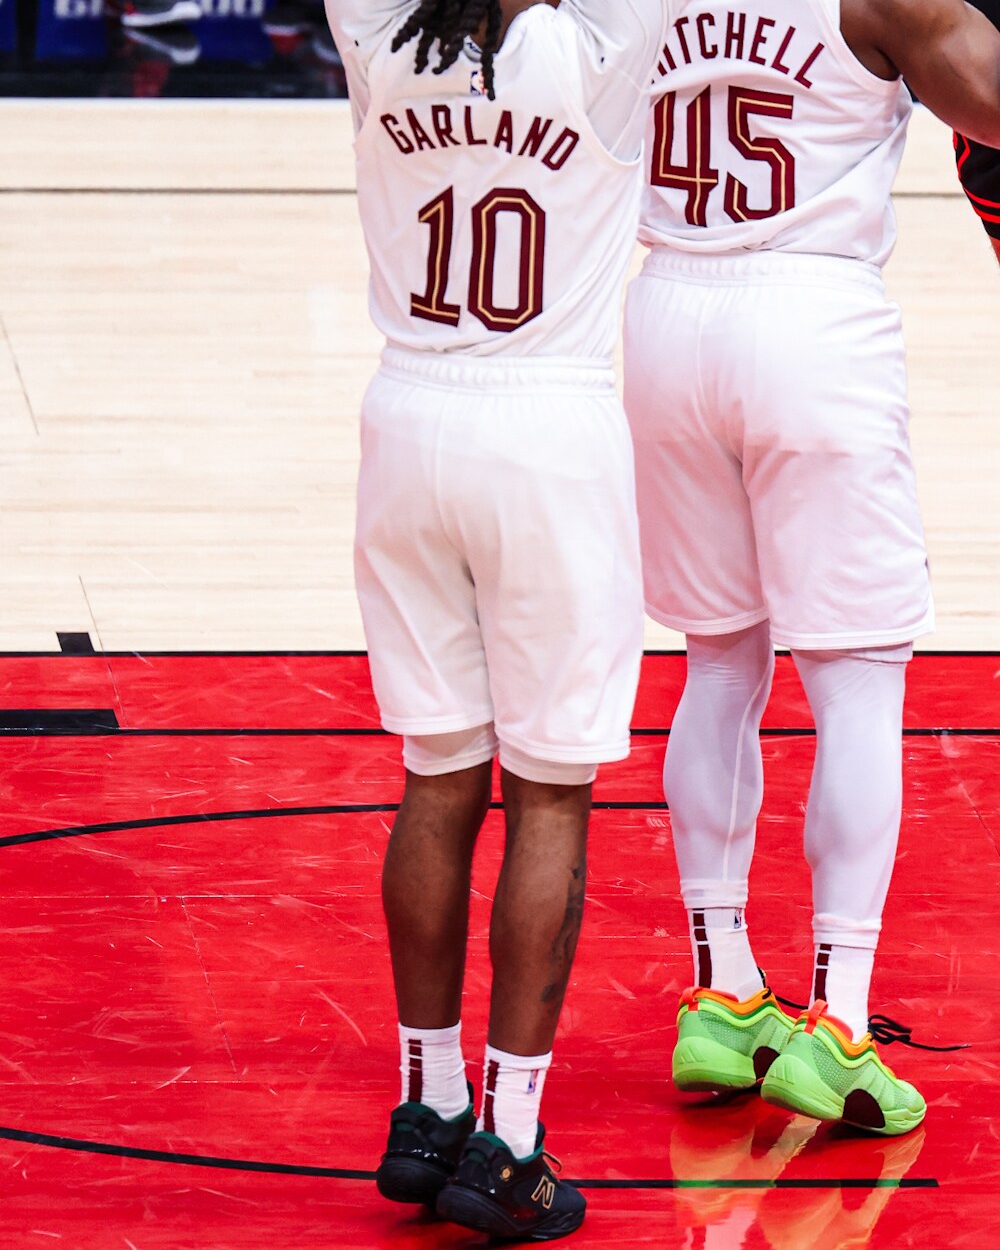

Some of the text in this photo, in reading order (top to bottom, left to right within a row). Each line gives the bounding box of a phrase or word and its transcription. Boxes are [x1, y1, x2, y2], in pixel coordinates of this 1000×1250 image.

[651, 11, 825, 89] ITCHELL
[380, 104, 580, 170] GARLAND
[651, 84, 796, 228] 45
[410, 185, 546, 333] 10
